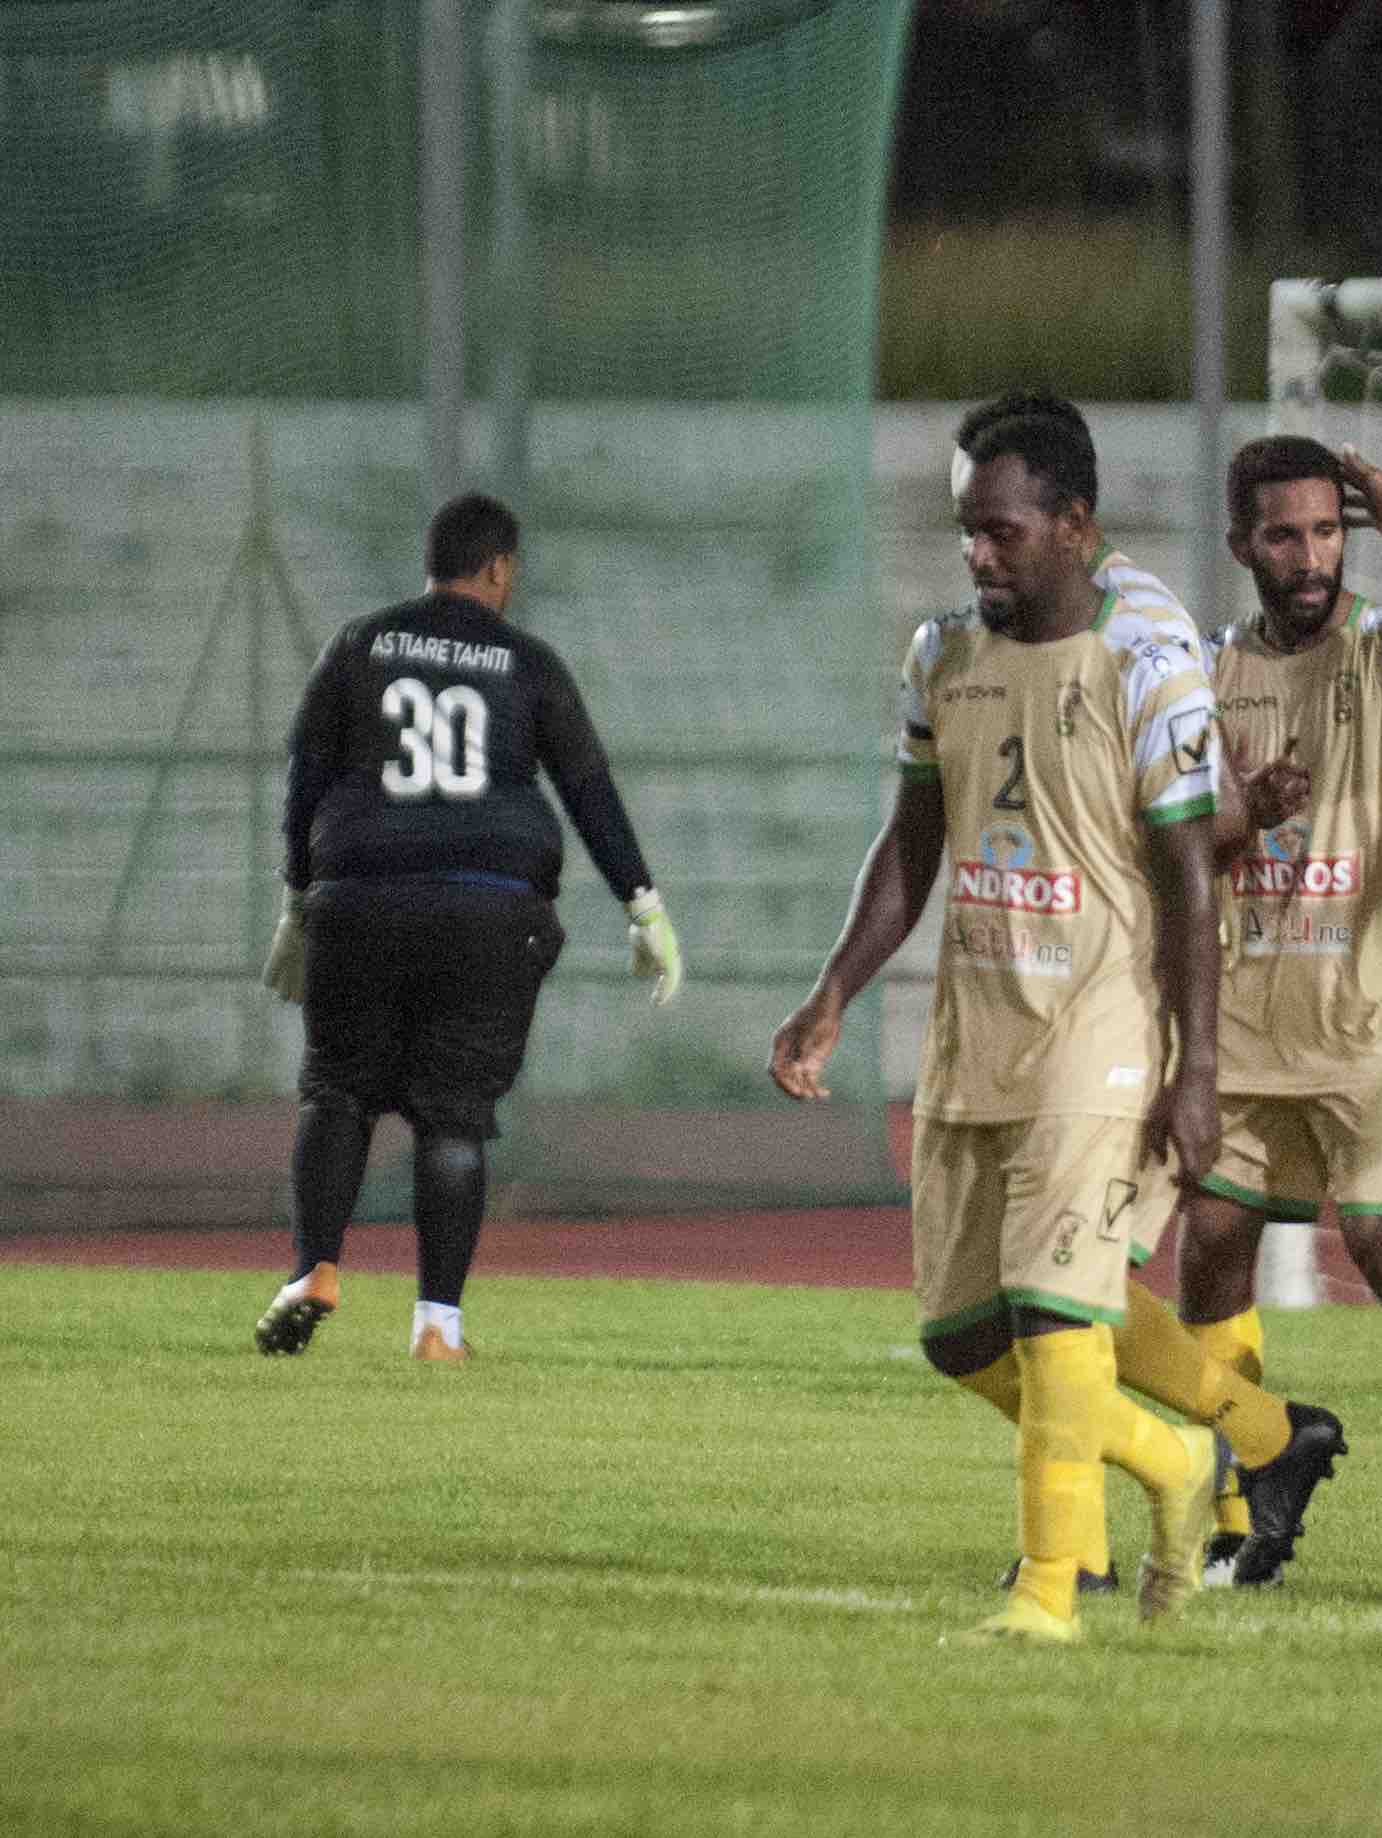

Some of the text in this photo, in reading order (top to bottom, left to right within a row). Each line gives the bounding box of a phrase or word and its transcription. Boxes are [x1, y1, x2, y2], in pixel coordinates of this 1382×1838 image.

[370, 632, 512, 672] AS TIARE TAHITI
[382, 677, 487, 794] 30
[994, 736, 1026, 810] 2
[958, 867, 1073, 911] NDROS
